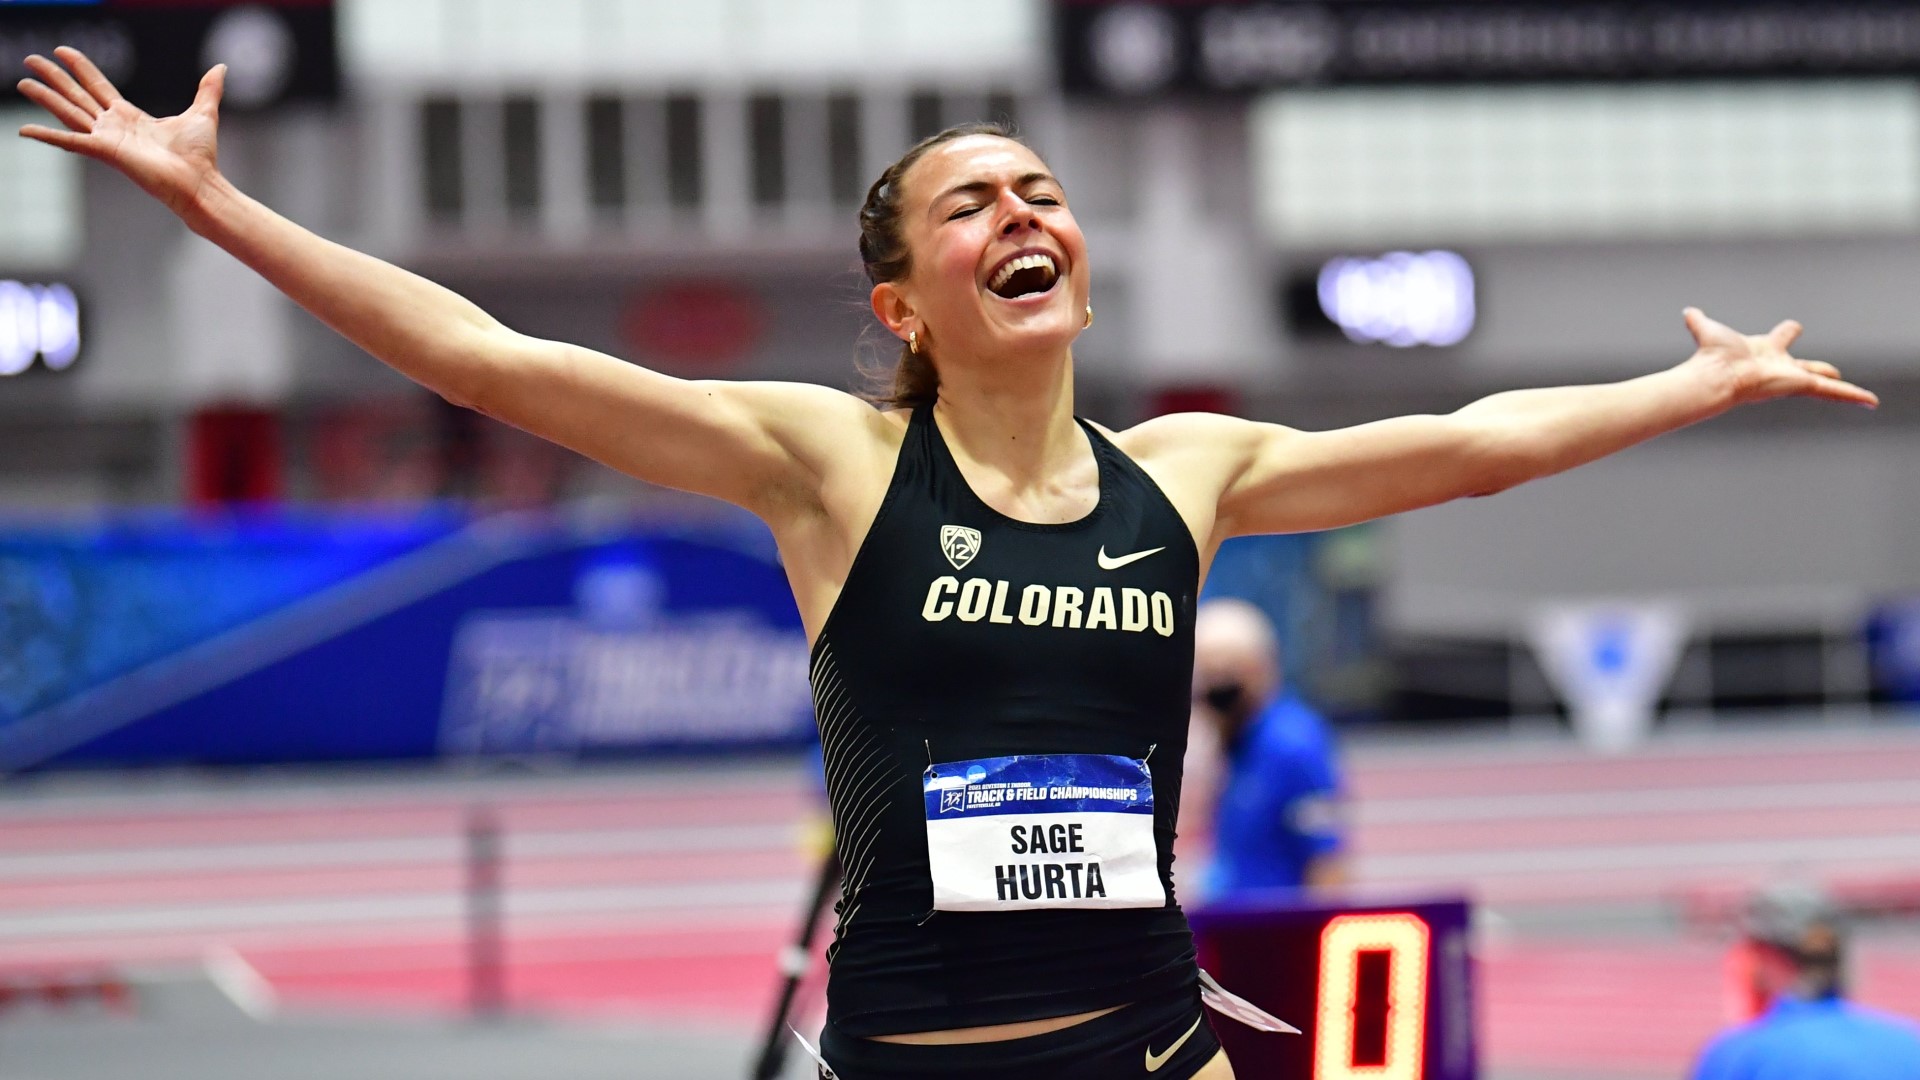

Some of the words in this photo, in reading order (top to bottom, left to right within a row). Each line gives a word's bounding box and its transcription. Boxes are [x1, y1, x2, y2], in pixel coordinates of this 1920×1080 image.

[943, 527, 979, 552] PAC
[951, 543, 970, 560] 12
[922, 576, 1174, 637] COLORADO
[967, 789, 1004, 803] TRACK
[1006, 788, 1015, 801] &
[1016, 788, 1047, 801] FIELD
[1050, 786, 1138, 801] CHAMPIONSHIPS
[1010, 823, 1084, 854] SAGE
[995, 862, 1107, 900] HURTA
[1313, 912, 1430, 1080] 0
